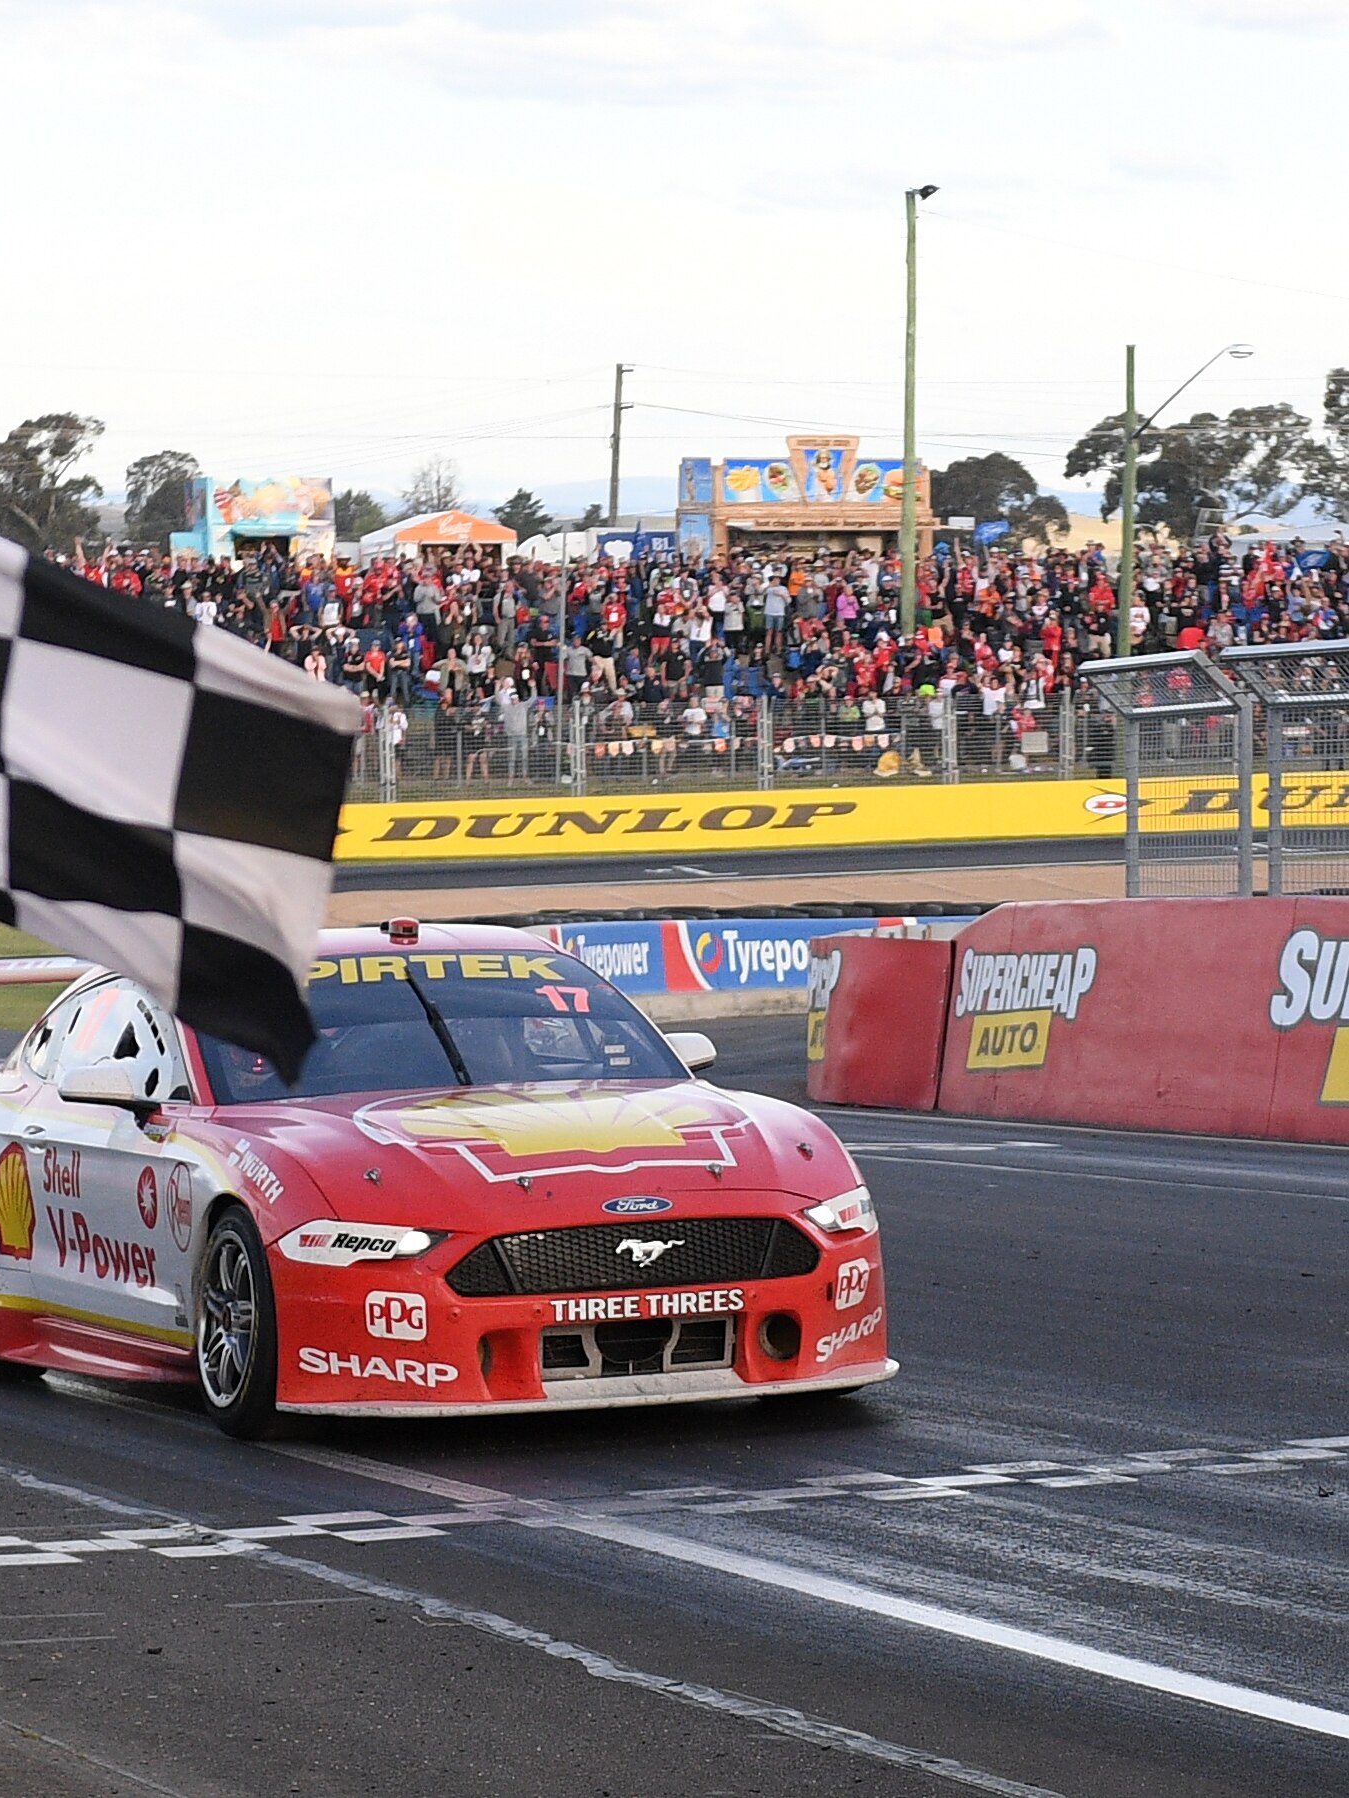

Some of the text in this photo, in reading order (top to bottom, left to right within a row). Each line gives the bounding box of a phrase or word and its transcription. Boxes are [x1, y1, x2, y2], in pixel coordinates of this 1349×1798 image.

[371, 802, 858, 842] DUNLOP
[303, 954, 566, 987] PIRTEK
[576, 934, 650, 982] Tyrepower
[535, 985, 590, 1013] 17
[956, 946, 1097, 1020] SUPERCHEAP
[975, 1021, 1037, 1057] AUTO
[43, 1146, 80, 1198] Shell
[238, 1150, 285, 1205] WÜRTH
[616, 1198, 660, 1212] Ford
[46, 1205, 156, 1288] V-Power
[331, 1233, 396, 1253] Repco
[838, 1265, 868, 1304] PPG
[369, 1297, 423, 1334] PPG
[551, 1288, 744, 1322] THREE THREES
[816, 1306, 883, 1363] SHARP
[299, 1347, 459, 1388] SHARP
